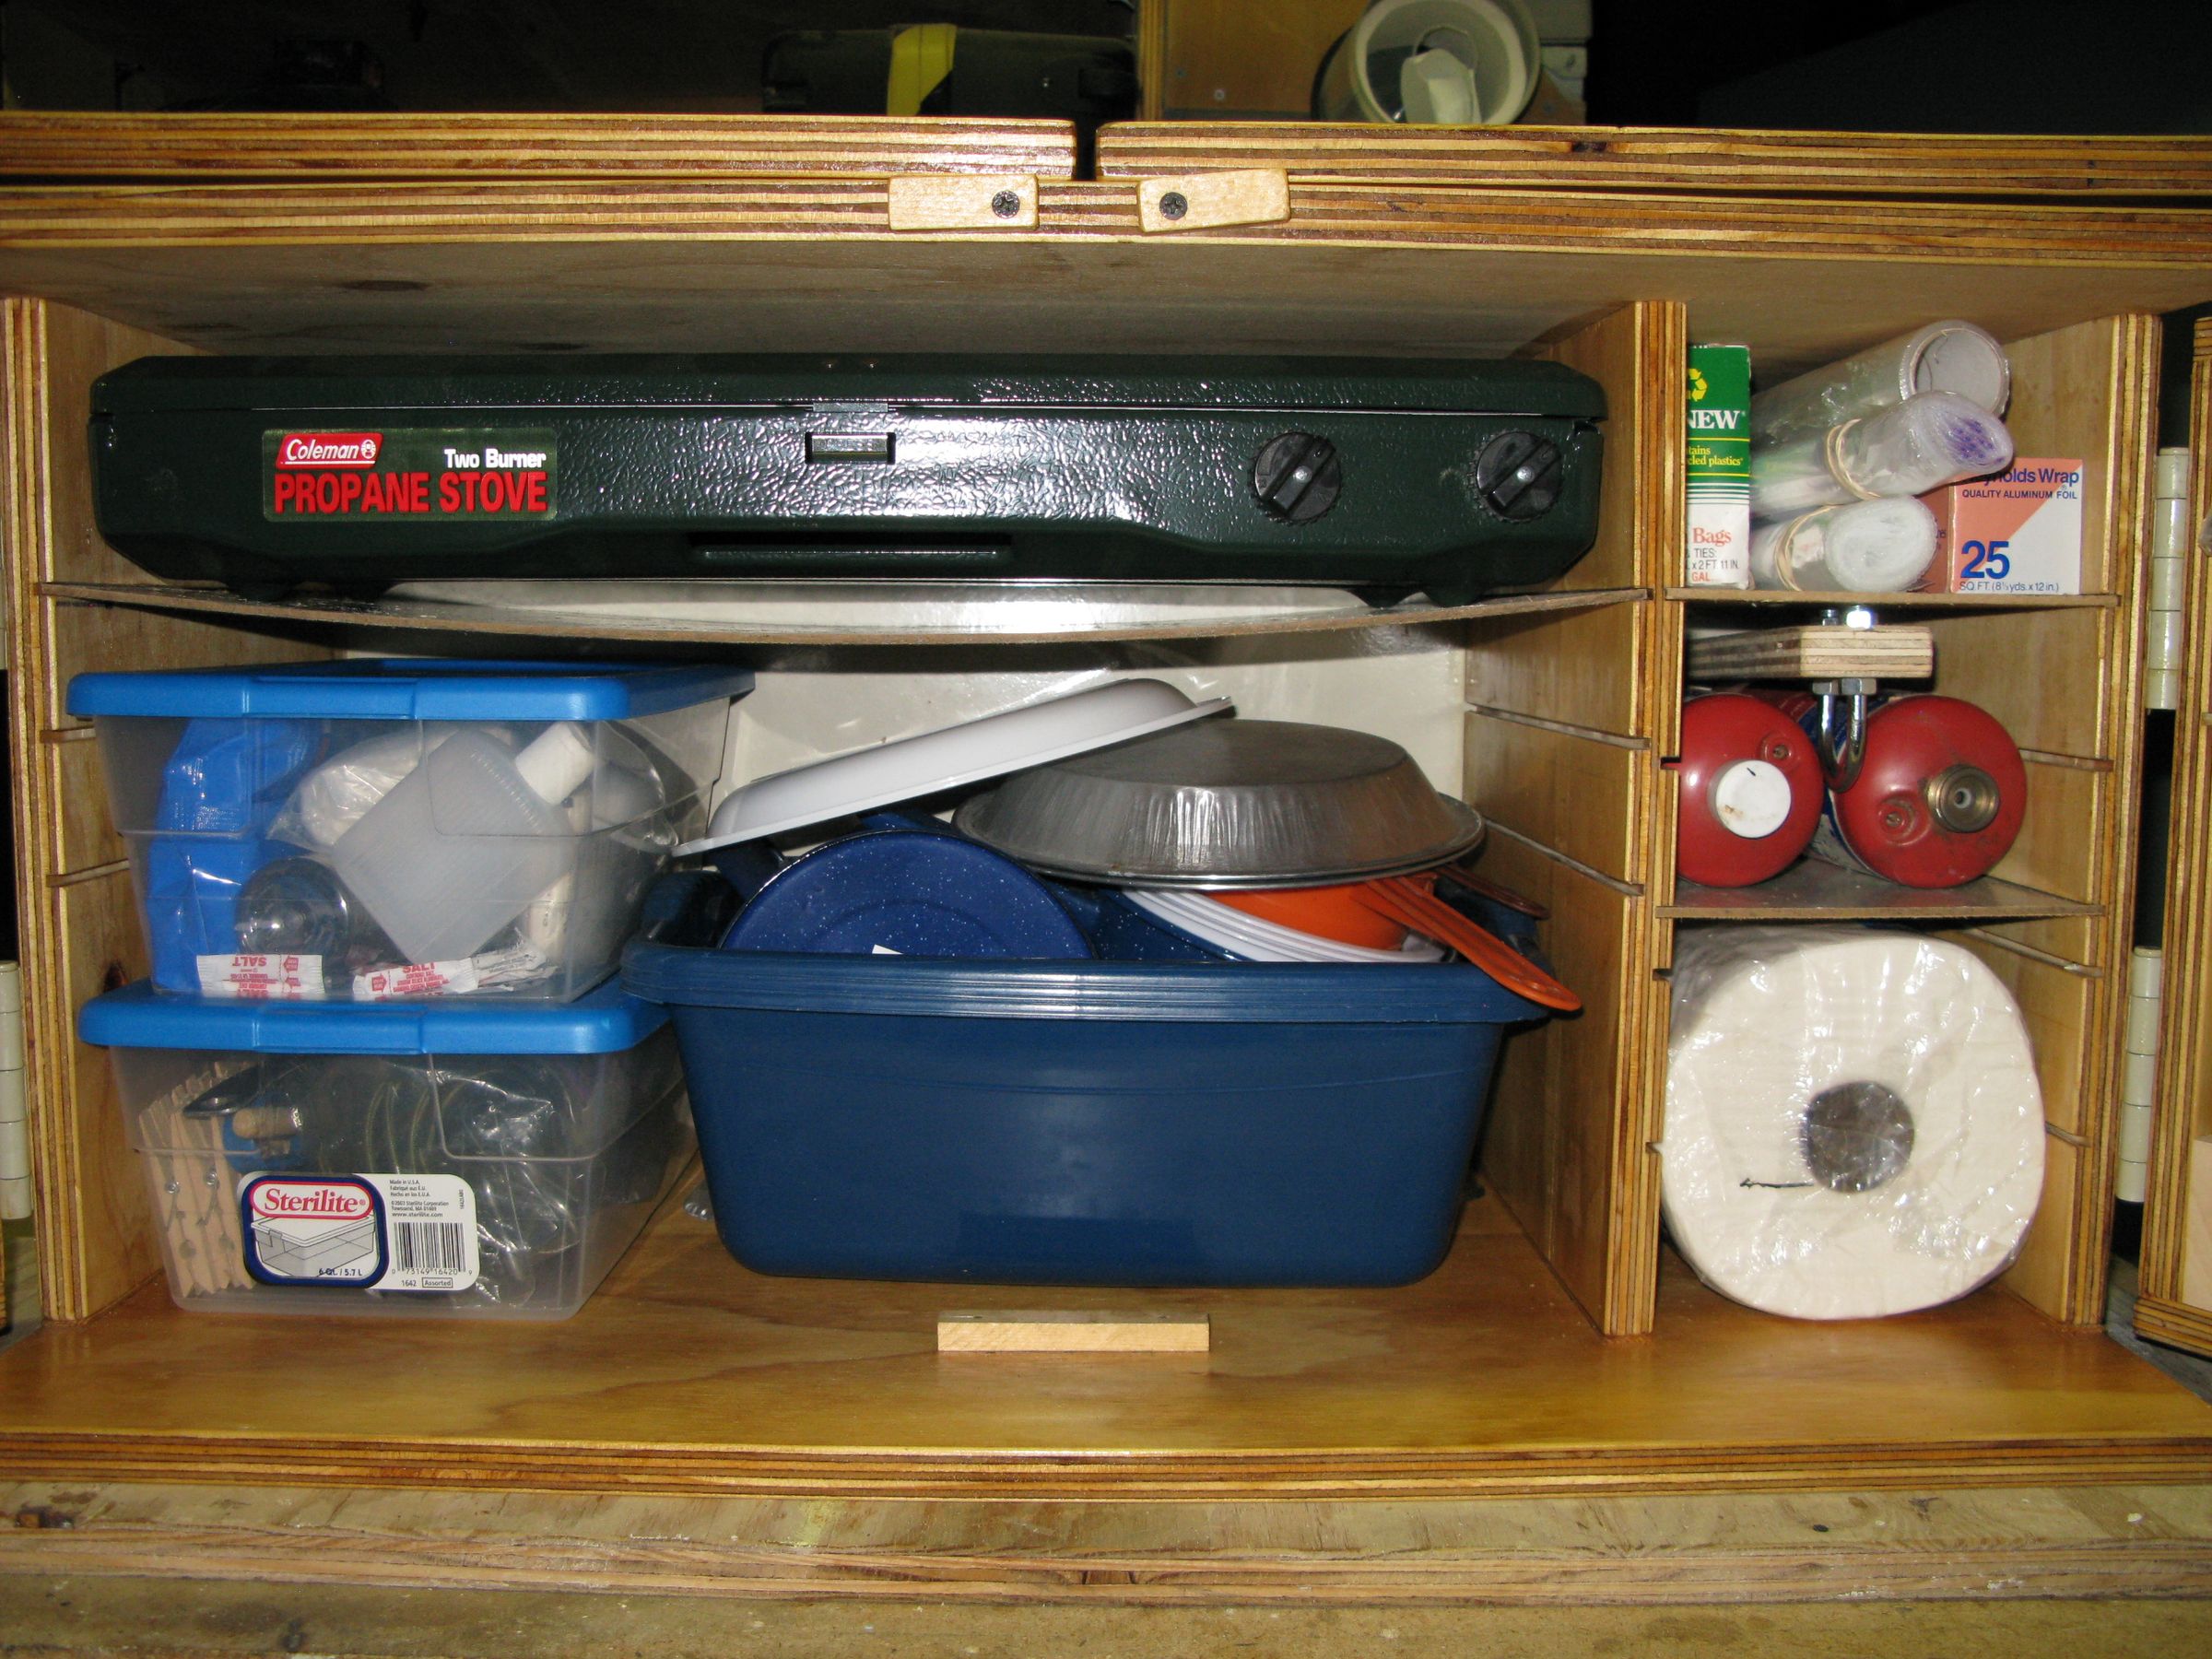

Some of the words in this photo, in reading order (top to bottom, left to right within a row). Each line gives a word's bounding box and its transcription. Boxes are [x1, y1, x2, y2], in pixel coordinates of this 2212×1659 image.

[286, 438, 359, 461] Coleman
[444, 448, 480, 468] Two
[485, 448, 547, 468] Burner
[2039, 468, 2079, 487] Wrap
[275, 472, 430, 512] PROPANE
[438, 471, 549, 512] STOVE
[1962, 489, 2001, 499] QUALITY
[2004, 489, 2053, 499] ALUMINUM
[2056, 490, 2077, 500] FOIL
[1693, 527, 1732, 547] Bags
[1699, 559, 1704, 570] 2
[1960, 540, 2010, 580] 25
[2035, 582, 2044, 591] 12
[232, 957, 267, 967] SALT
[265, 1188, 358, 1213] Sterilite
